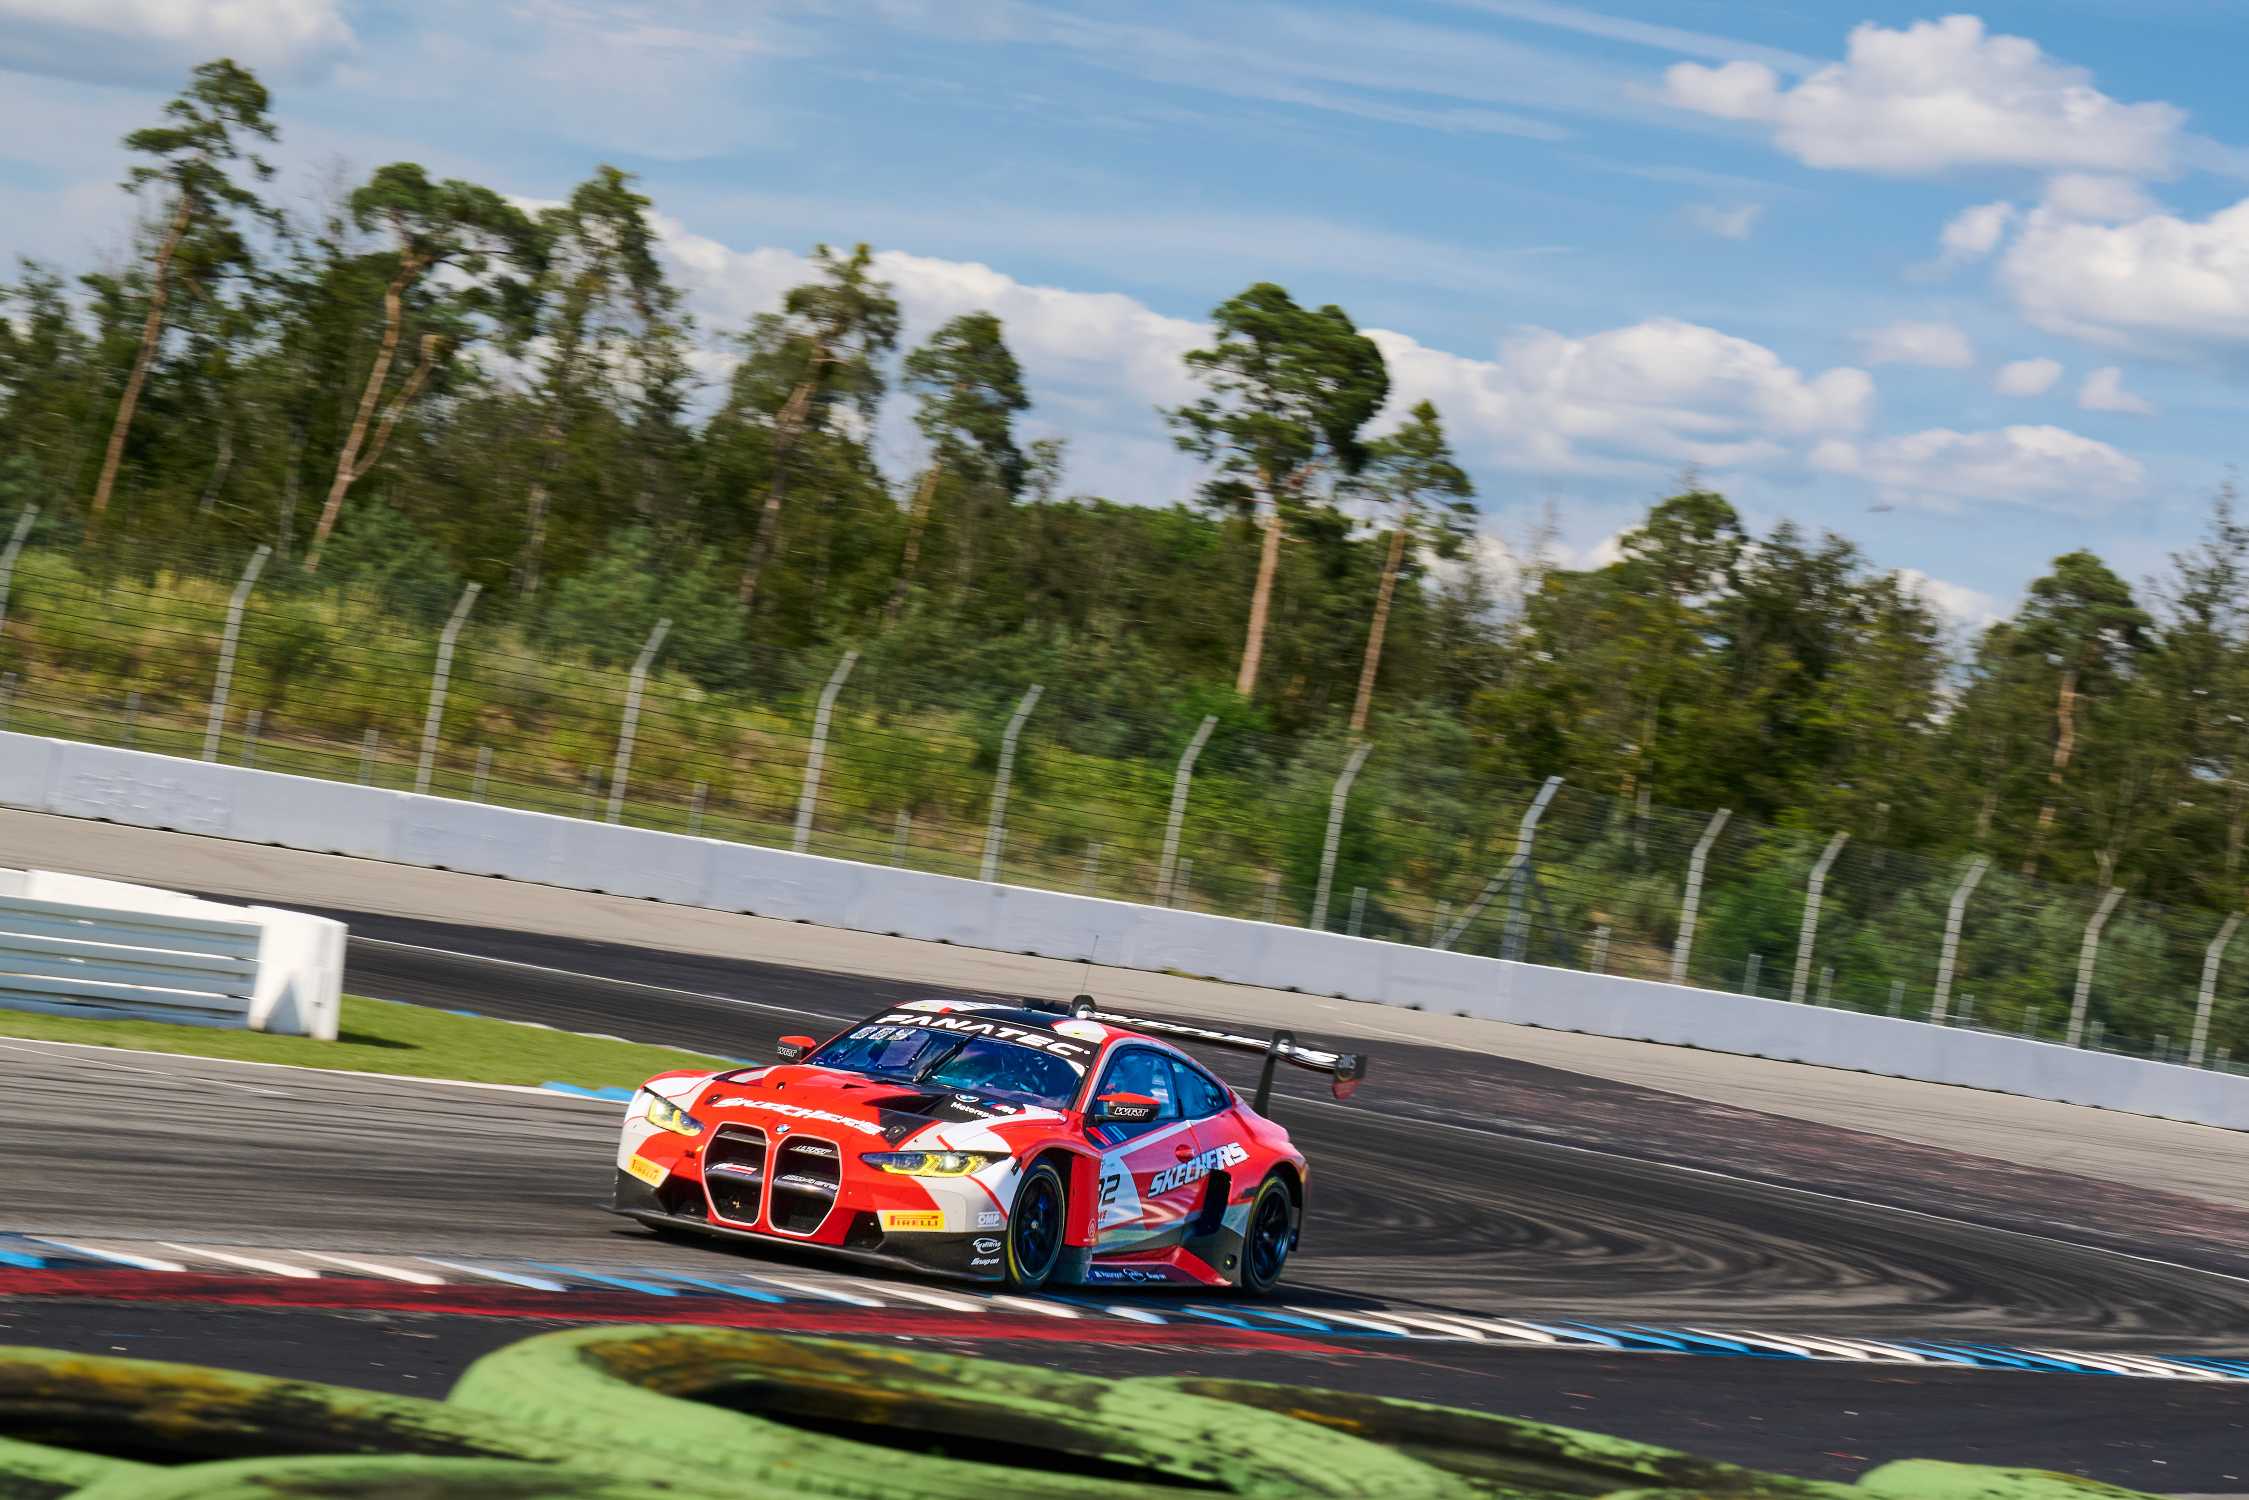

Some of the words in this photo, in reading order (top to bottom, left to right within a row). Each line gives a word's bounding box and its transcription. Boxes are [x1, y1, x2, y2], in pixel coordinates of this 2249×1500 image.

[874, 1014, 1086, 1055] FANATEC
[950, 1101, 1000, 1118] Motorspo
[1114, 1106, 1149, 1117] WRT
[1147, 1142, 1250, 1198] SKECHERS
[889, 1214, 939, 1226] PIRELLI
[978, 1214, 1000, 1225] OMP
